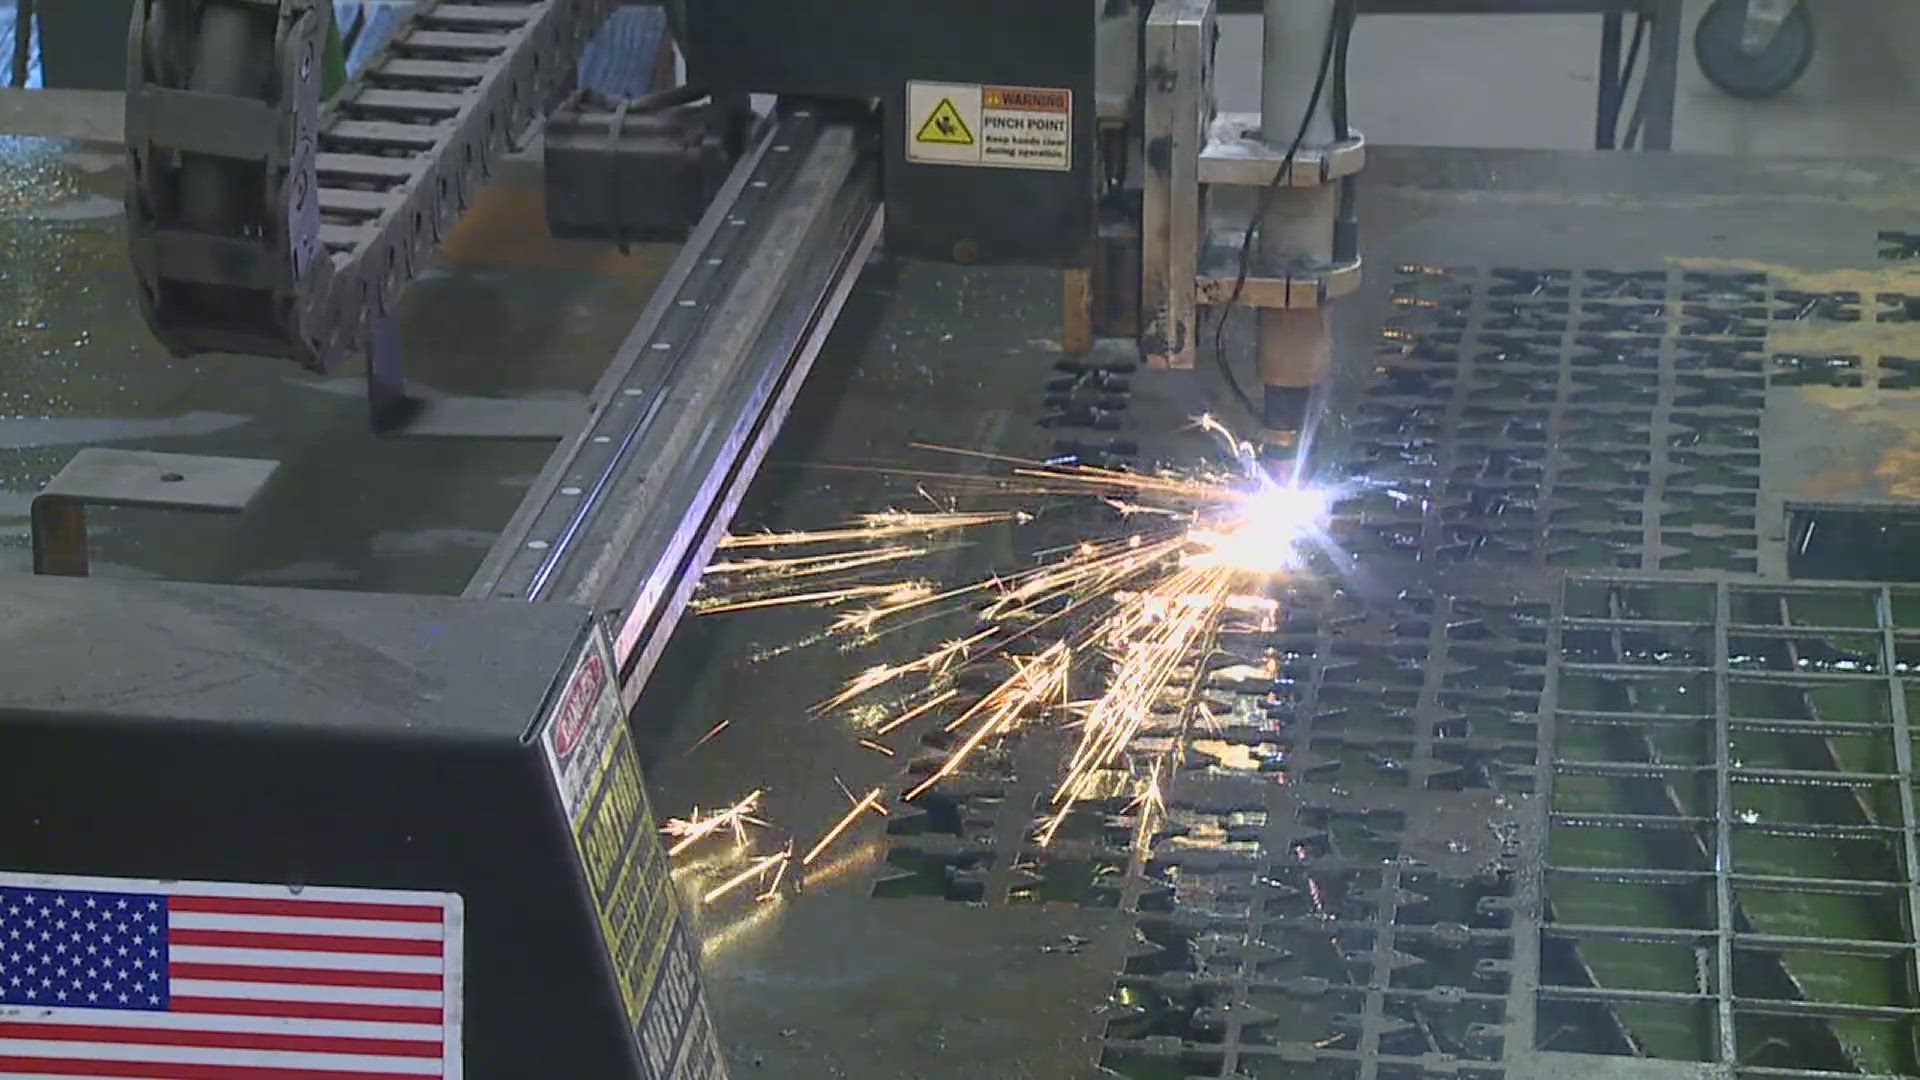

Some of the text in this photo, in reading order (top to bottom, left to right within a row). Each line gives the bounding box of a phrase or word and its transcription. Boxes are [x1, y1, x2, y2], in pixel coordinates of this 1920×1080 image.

[1002, 93, 1063, 107] WARNING
[985, 117, 1064, 131] PINCH POINT
[985, 135, 1066, 146] Keep hands clear
[986, 147, 1015, 157] during
[583, 745, 641, 897] CAUTION
[642, 930, 696, 1080] NOTICE
